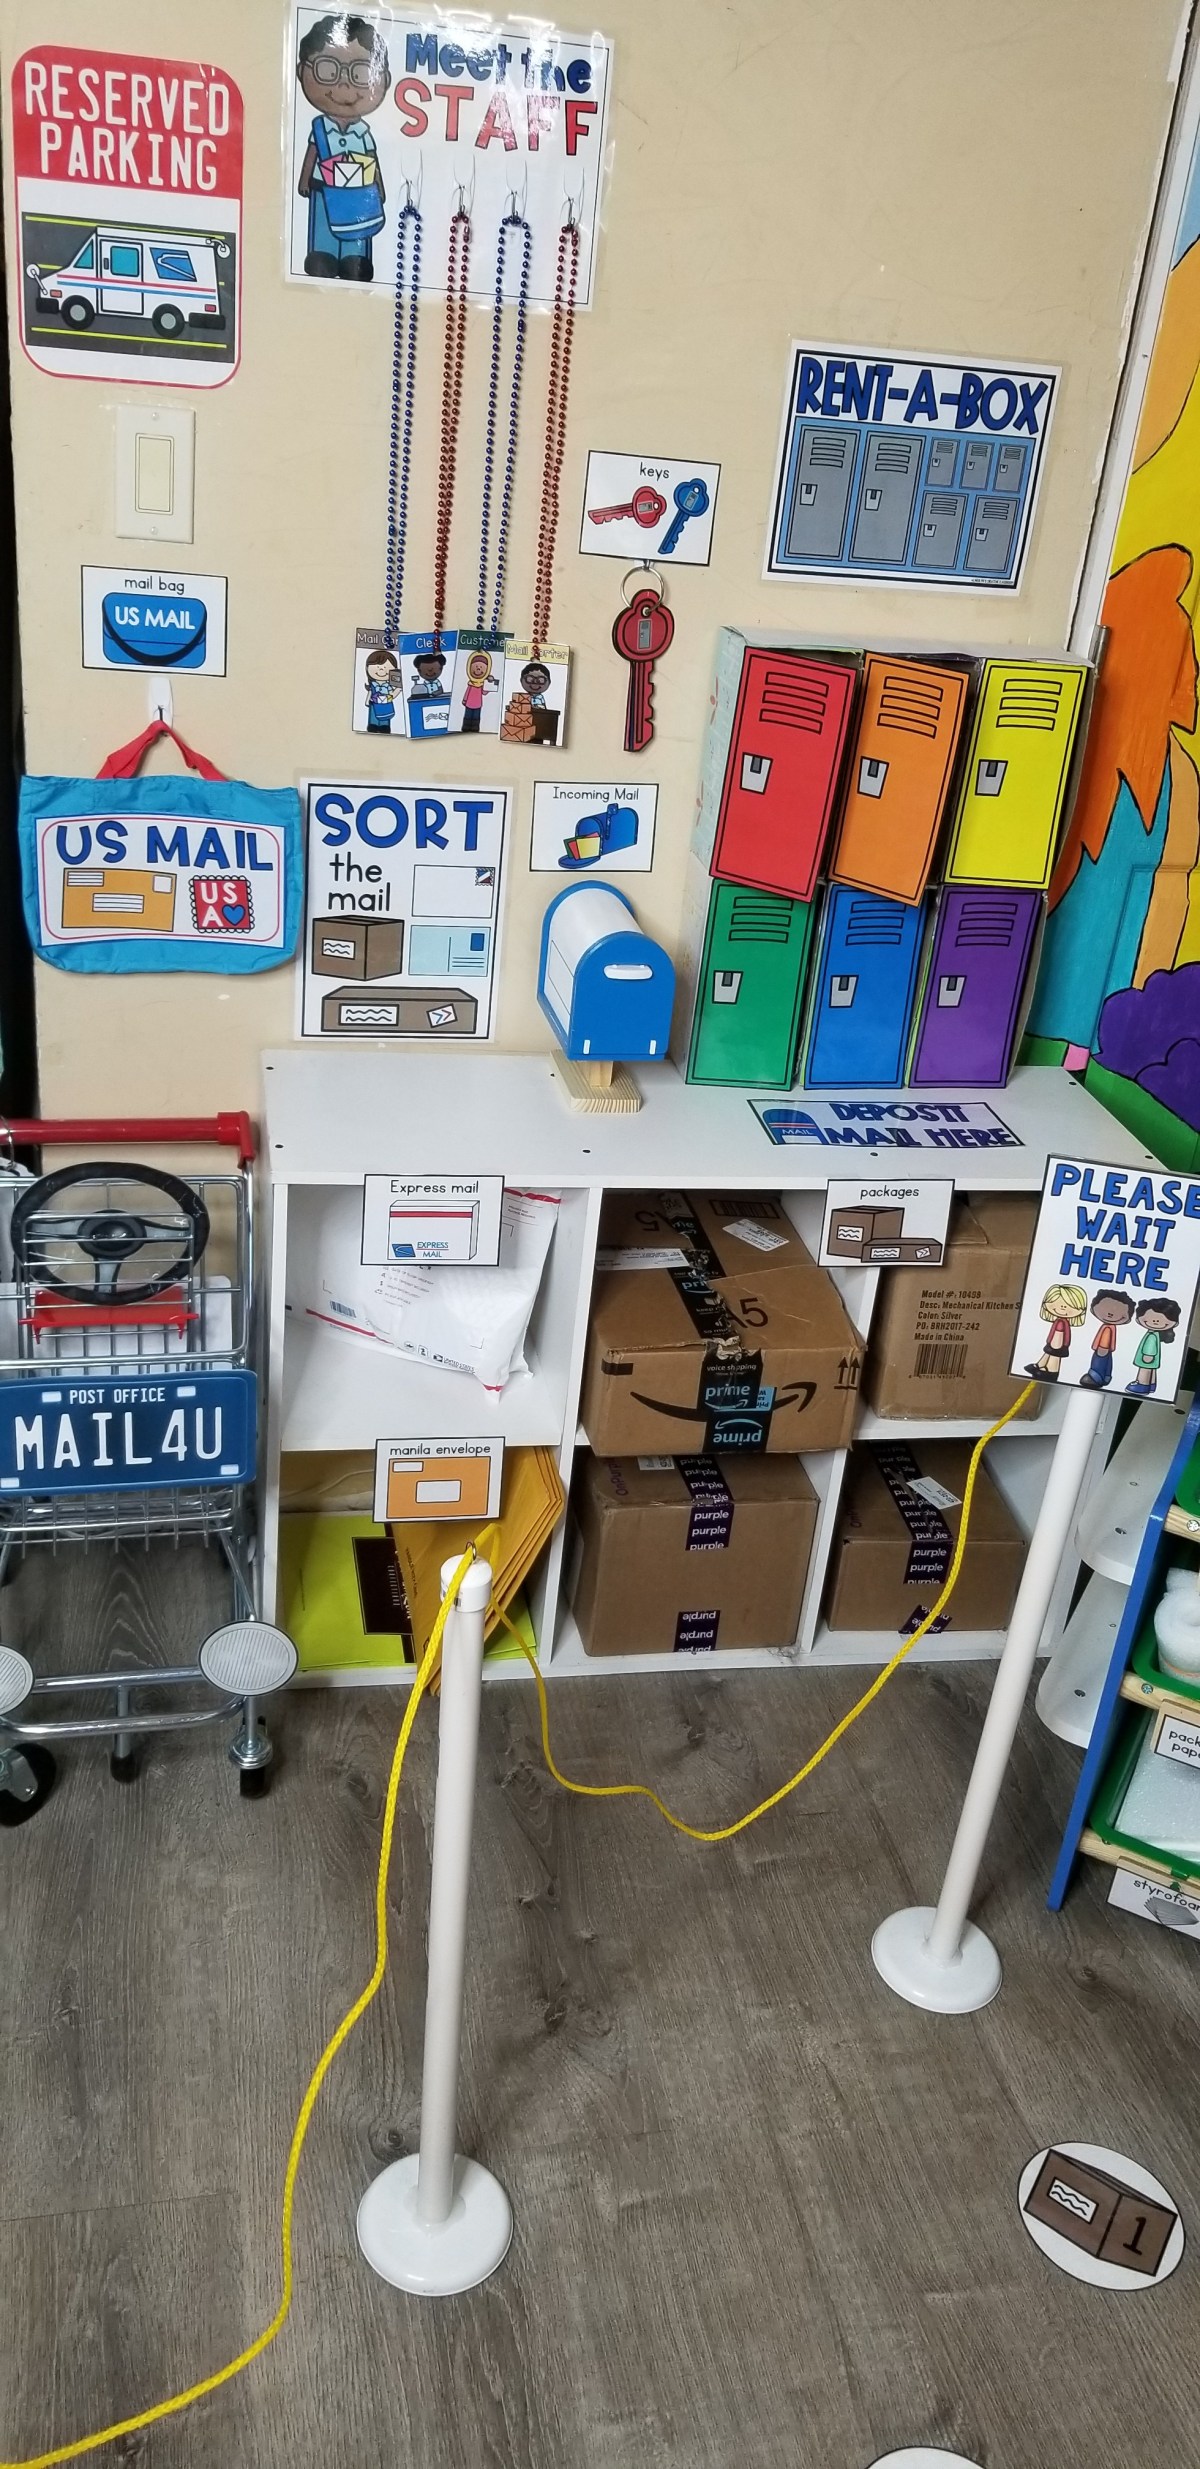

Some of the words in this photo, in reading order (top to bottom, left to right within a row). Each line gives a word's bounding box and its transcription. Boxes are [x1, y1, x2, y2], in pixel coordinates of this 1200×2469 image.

[405, 33, 513, 86] Meet
[520, 46, 592, 94] the
[24, 61, 231, 138] RESERVED
[393, 77, 599, 156] STAFF
[40, 122, 218, 191] PARKING
[795, 356, 1049, 435] RENT-A-BOX
[639, 461, 670, 480] keys
[124, 576, 153, 591] mail
[159, 576, 186, 595] bag
[115, 605, 140, 626] US
[145, 608, 196, 631] MAIL
[357, 632, 379, 645] Mail
[416, 636, 447, 649] Clek
[460, 634, 505, 647] Custome
[507, 643, 528, 656] Mail
[531, 646, 568, 660] orter
[552, 786, 610, 803] Incoming
[615, 787, 640, 801] Mail
[315, 792, 495, 852] SORT
[56, 820, 128, 865] US
[147, 825, 274, 871] MAIL
[329, 851, 383, 883] the
[200, 882, 238, 904] US
[327, 882, 391, 912] mail
[202, 905, 223, 927] A
[829, 1103, 972, 1123] DEPOSIT
[781, 1127, 814, 1136] MAIL
[823, 1127, 922, 1147] MAIL
[928, 1127, 1018, 1148] HERE
[390, 1180, 446, 1196] Express
[451, 1180, 479, 1194] mail
[860, 1185, 920, 1200] packages
[1050, 1163, 1200, 1219] PLEASE
[1077, 1206, 1176, 1252] WAIT
[417, 1241, 450, 1249] EXPRESS
[422, 1250, 443, 1258] MAIL
[1059, 1243, 1170, 1292] HERE
[921, 1290, 944, 1298] Model
[919, 1301, 940, 1309] Desc:
[942, 1301, 985, 1310] Mechanical
[985, 1302, 1014, 1310] Kitchen
[917, 1311, 939, 1320] Color:
[940, 1311, 963, 1320] Silver
[914, 1332, 934, 1341] Made
[935, 1332, 942, 1341] in
[943, 1333, 965, 1341] China
[706, 1364, 726, 1372] voice
[727, 1363, 757, 1371] shpping
[69, 1388, 105, 1405] POST
[113, 1387, 166, 1404] OFFICE
[705, 1383, 751, 1401] prime
[15, 1407, 223, 1471] MAIL4U
[712, 1429, 762, 1447] prime
[389, 1443, 431, 1456] manila
[436, 1442, 491, 1457] envelope
[693, 1509, 730, 1522] purple
[691, 1525, 727, 1538] purple
[913, 1548, 947, 1558] purple
[909, 1563, 944, 1573] purple
[682, 1610, 717, 1622] purple
[679, 1629, 714, 1641] purple
[1171, 1743, 1200, 1758] pap
[1122, 2216, 1147, 2256] 1
